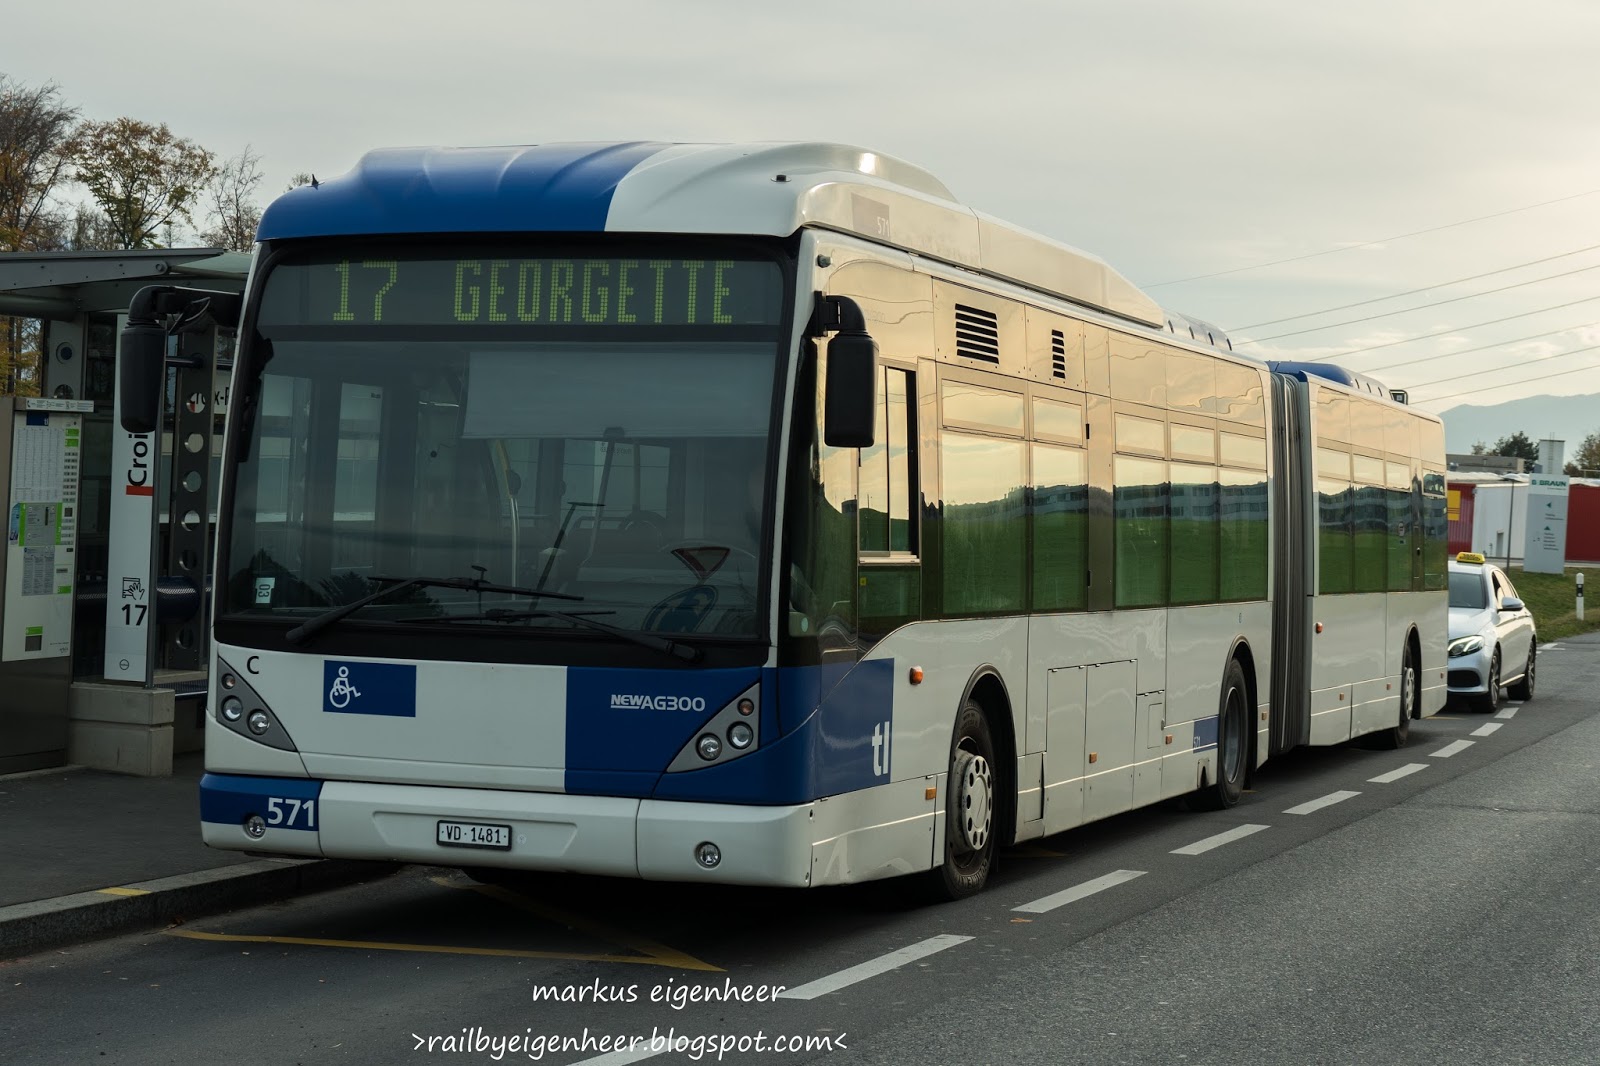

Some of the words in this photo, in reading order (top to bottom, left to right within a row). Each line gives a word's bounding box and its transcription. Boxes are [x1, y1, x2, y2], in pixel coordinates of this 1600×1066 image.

[877, 216, 890, 238] 571
[333, 260, 398, 322] 17
[454, 259, 735, 324] GEORGETTE
[121, 604, 147, 626] 17
[247, 656, 259, 674] C
[872, 721, 890, 777] tl
[267, 797, 315, 827] 571
[446, 825, 461, 841] VD
[470, 826, 501, 843] 1481
